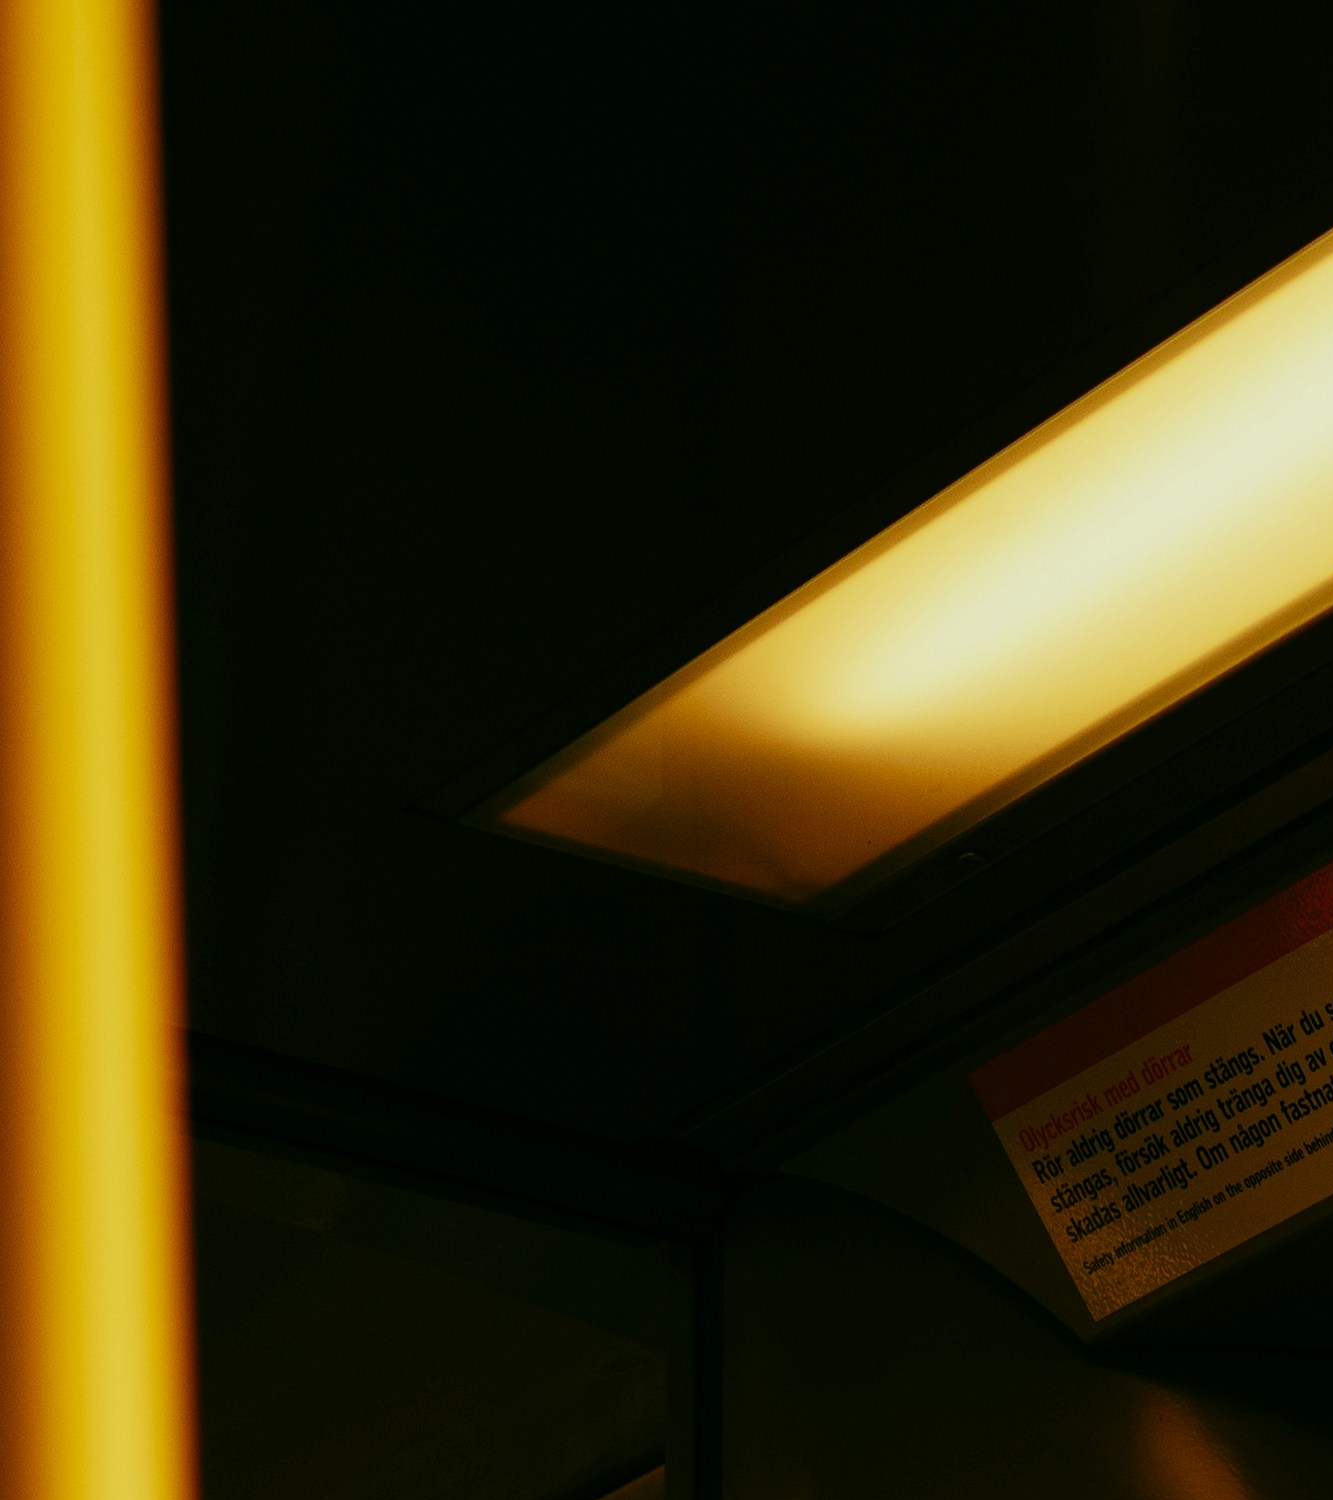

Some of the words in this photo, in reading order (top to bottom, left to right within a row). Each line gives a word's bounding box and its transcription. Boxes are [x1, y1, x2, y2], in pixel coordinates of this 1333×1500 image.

[1018, 1092, 1105, 1153] Olycksrisk
[1101, 1068, 1142, 1108] med
[1140, 1043, 1194, 1087] dörrar
[1031, 1153, 1065, 1185] Rör
[1065, 1127, 1116, 1168] aldrig
[1113, 1098, 1166, 1141] dörrar
[1166, 1078, 1205, 1111] som
[1203, 1046, 1266, 1090] stängs.
[1261, 1022, 1298, 1056] När
[1298, 1009, 1326, 1036] du
[1082, 1251, 1116, 1276] Safety
[1112, 1223, 1168, 1260] information
[1163, 1216, 1179, 1231] in
[1175, 1196, 1214, 1225] English
[1212, 1190, 1228, 1206] on
[1224, 1181, 1245, 1199] the
[1242, 1159, 1285, 1190] opposite
[1283, 1147, 1306, 1168] side
